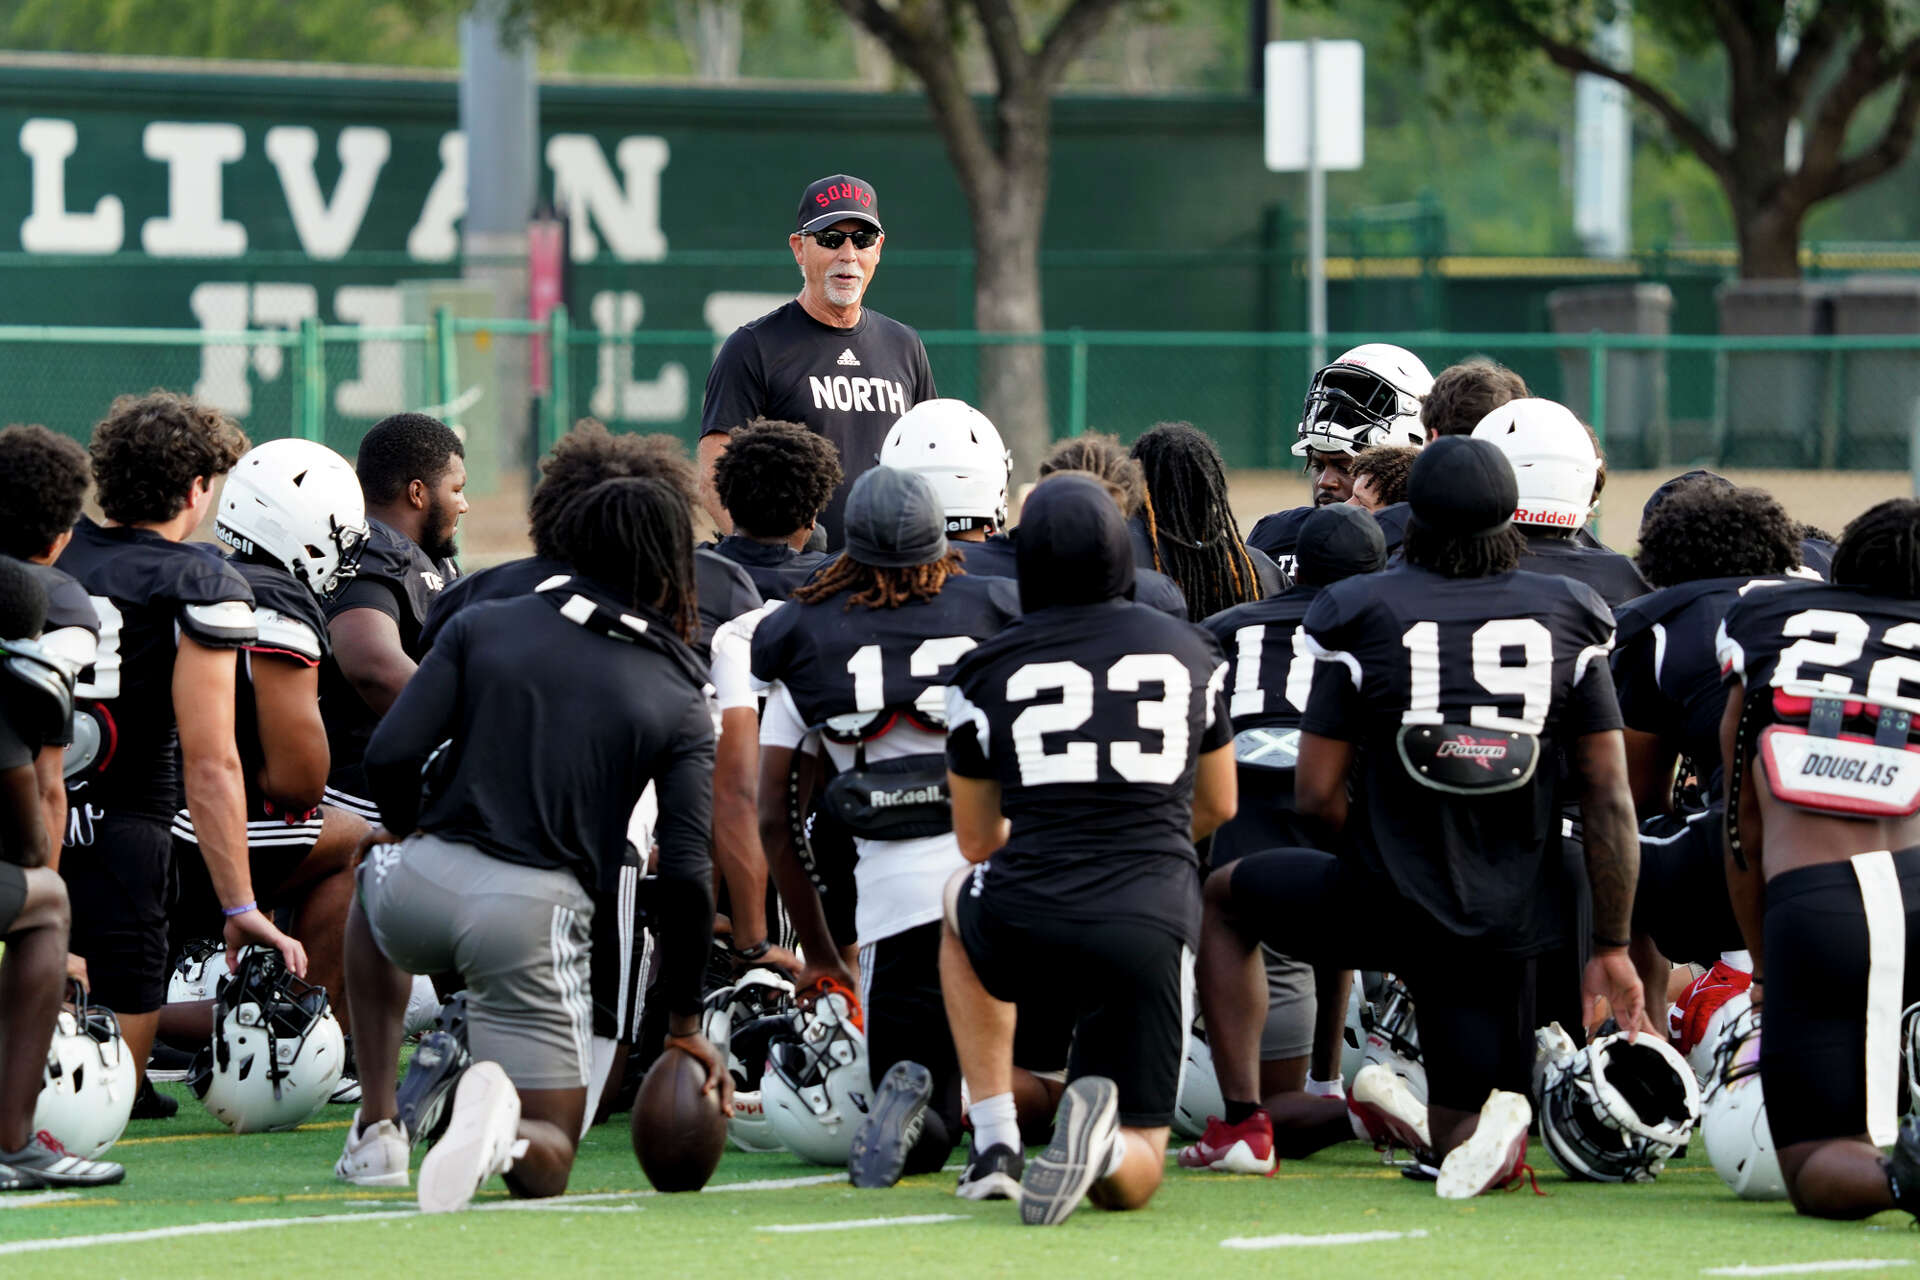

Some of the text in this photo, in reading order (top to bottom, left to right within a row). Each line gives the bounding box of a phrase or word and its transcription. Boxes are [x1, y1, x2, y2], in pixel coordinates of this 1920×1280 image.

[815, 182, 872, 208] CARDS
[808, 375, 907, 417] NORTH
[1513, 508, 1577, 526] Riddell
[1401, 618, 1554, 735] 19
[1006, 653, 1192, 787] 23
[1801, 752, 1899, 787] DOUGLAS
